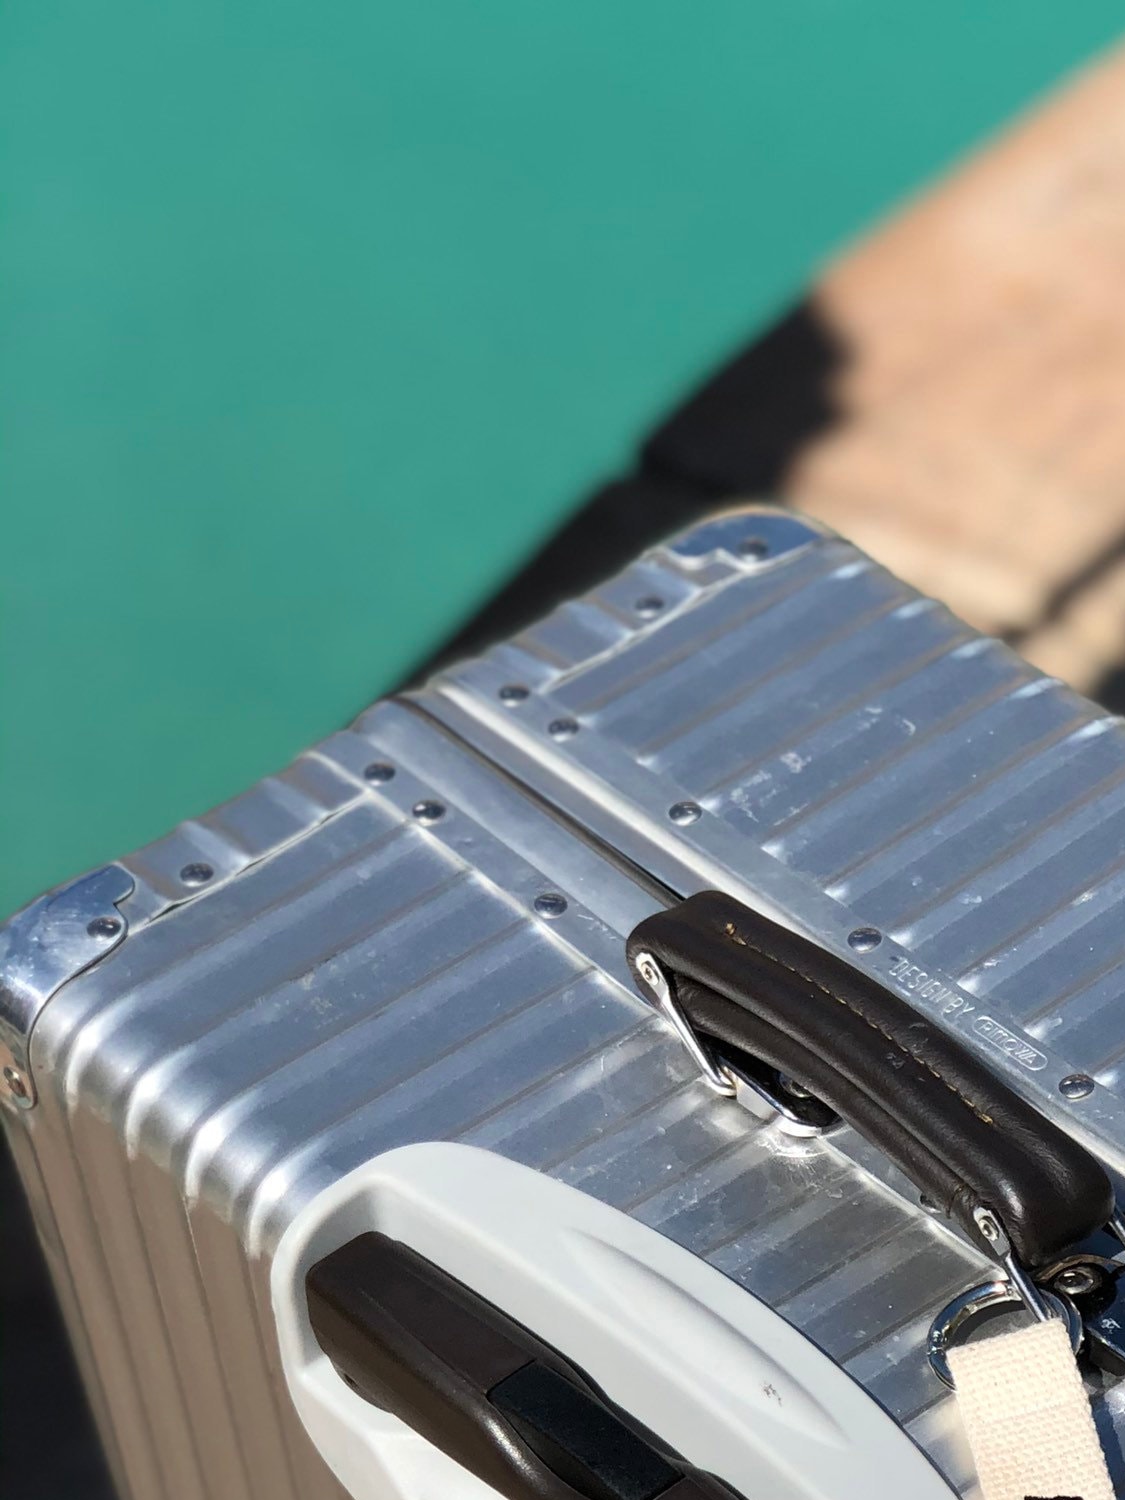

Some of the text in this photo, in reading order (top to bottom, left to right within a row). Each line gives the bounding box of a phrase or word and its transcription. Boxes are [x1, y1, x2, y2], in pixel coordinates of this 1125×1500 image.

[889, 957, 1038, 1065] DESIGN BY RIMOWA
